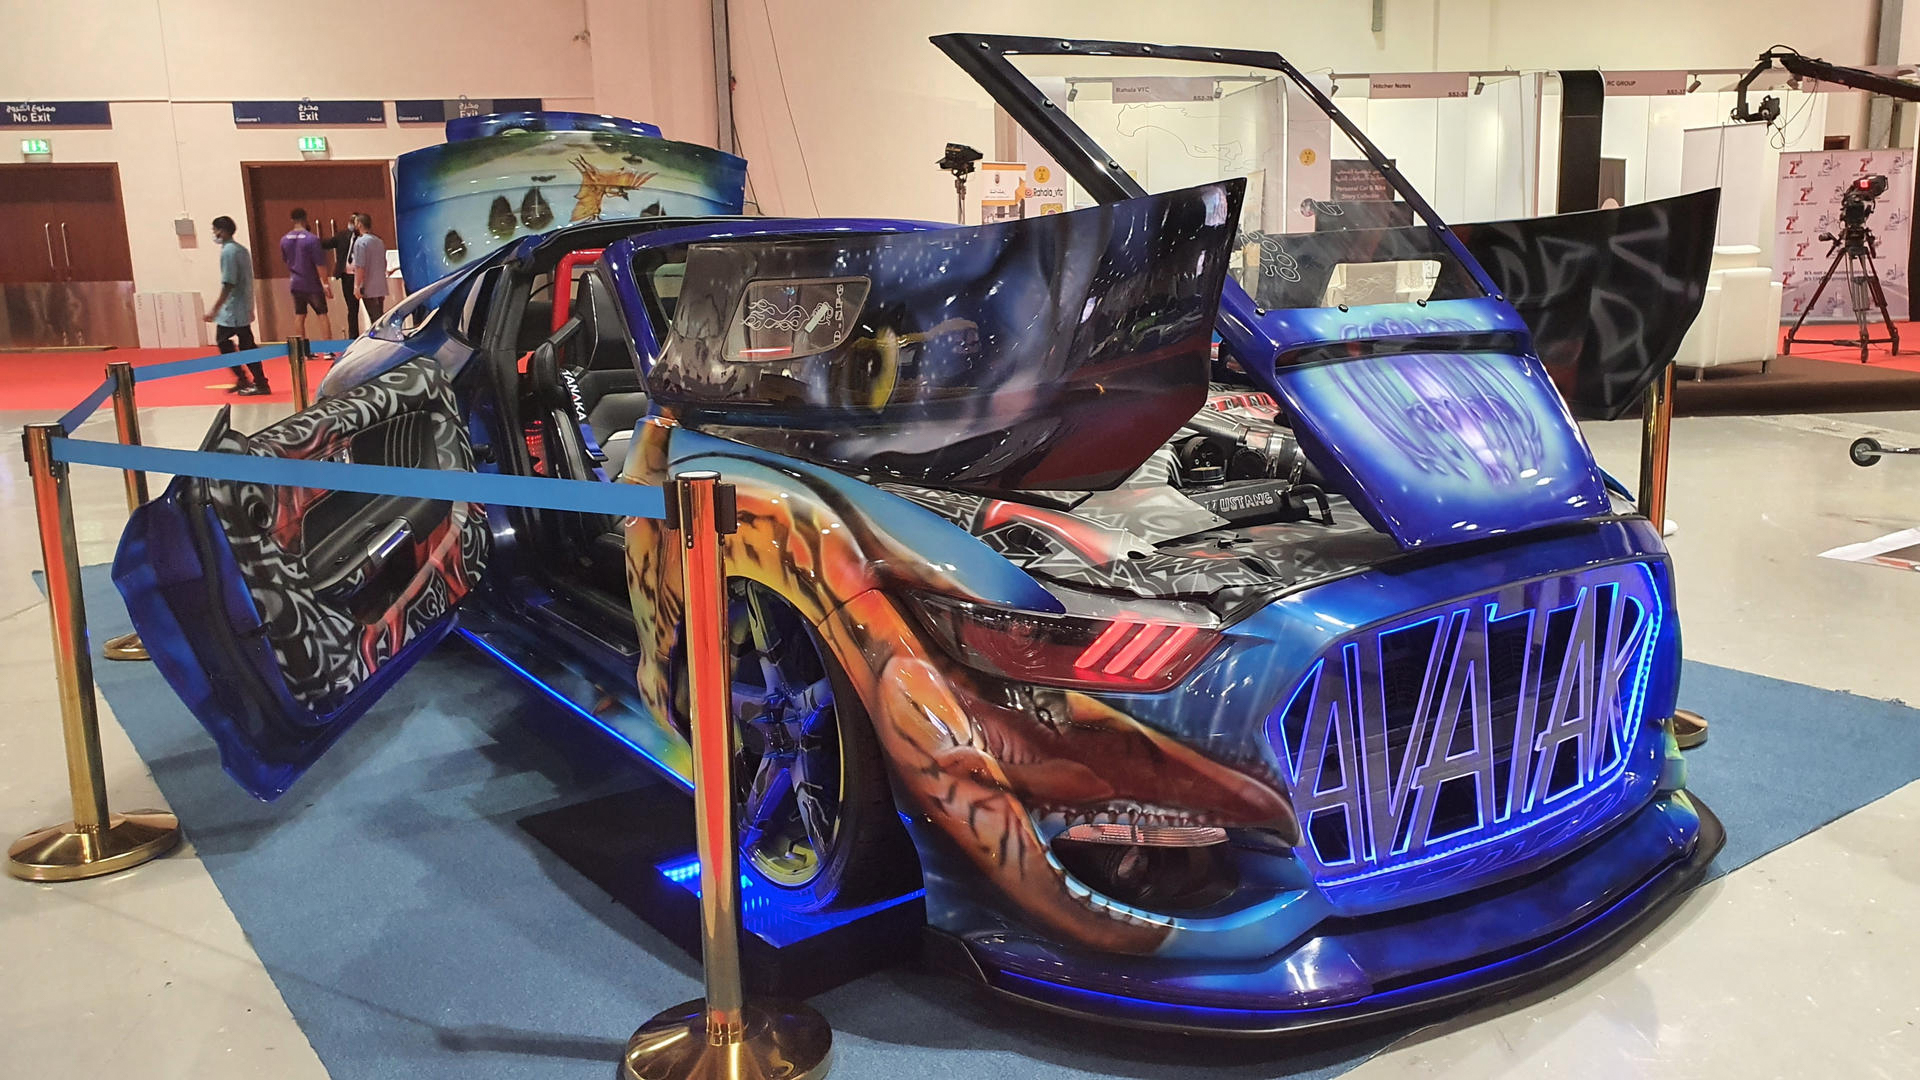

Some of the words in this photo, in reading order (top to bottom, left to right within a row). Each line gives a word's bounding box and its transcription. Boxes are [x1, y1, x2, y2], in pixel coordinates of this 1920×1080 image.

[298, 103, 319, 112] مخرج
[13, 113, 28, 122] No
[30, 112, 51, 122] Exit
[299, 112, 319, 121] Exit
[1033, 187, 1064, 198] Rahala_vtc
[562, 368, 587, 421] TANAKA
[1286, 582, 1652, 868] AVATAR
